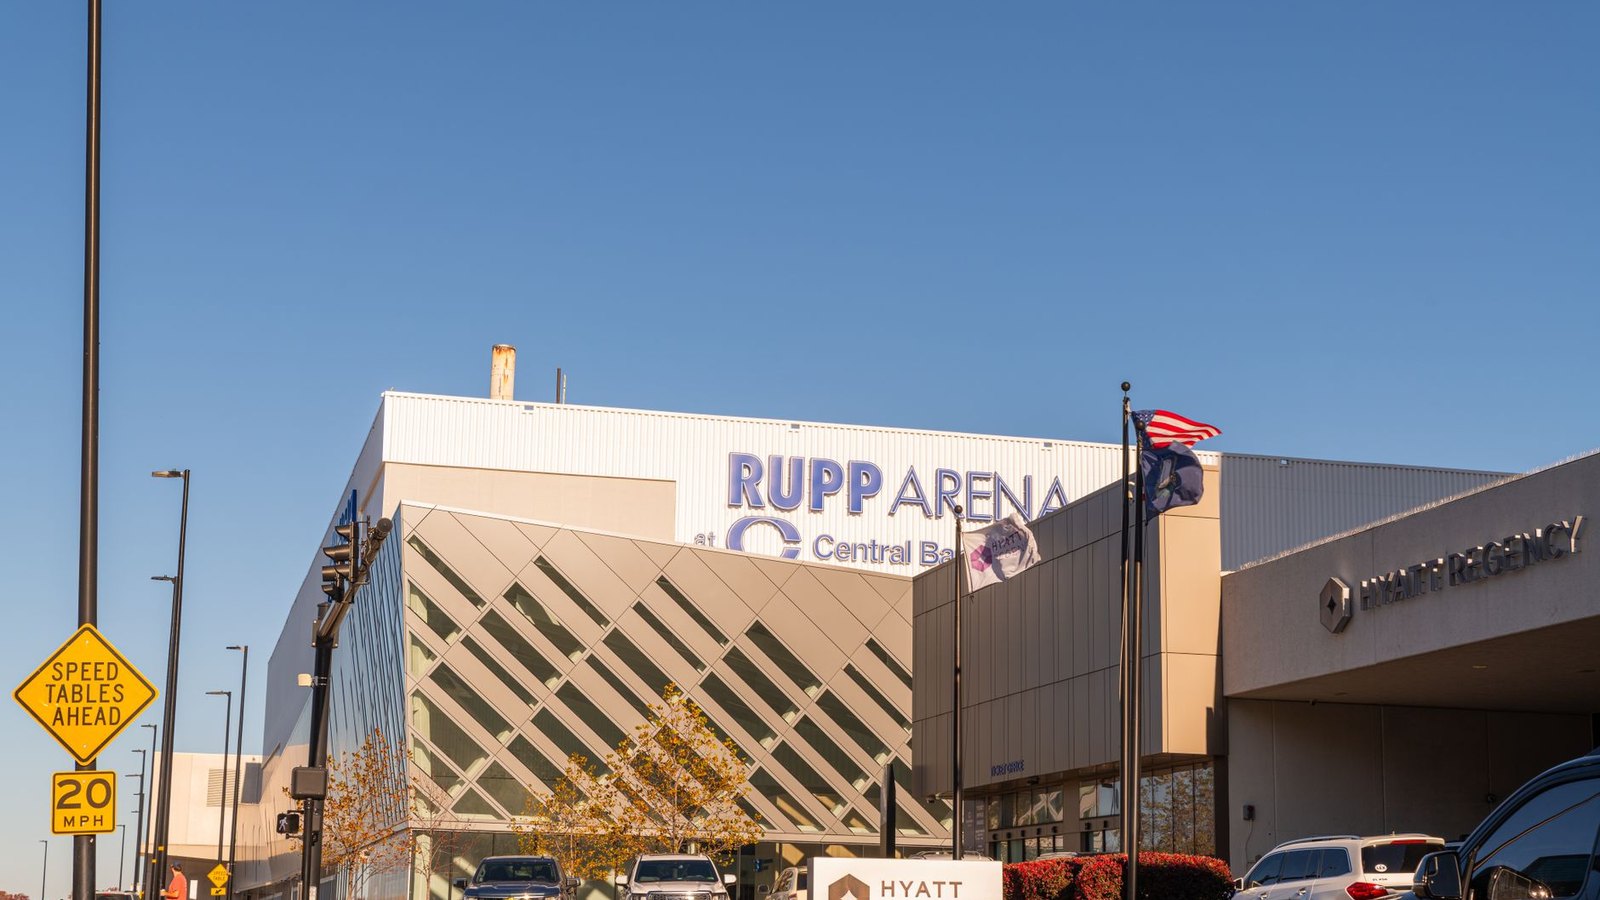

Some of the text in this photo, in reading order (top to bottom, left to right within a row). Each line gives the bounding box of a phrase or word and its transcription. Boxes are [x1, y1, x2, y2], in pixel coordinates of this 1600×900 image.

[728, 451, 1070, 523] RUPP ARENA
[694, 530, 715, 547] at
[813, 534, 912, 564] Central
[920, 540, 956, 566] Ba
[1360, 515, 1585, 611] HYATT REGENCY
[52, 662, 118, 681] SPEED
[45, 684, 124, 703] TABLES
[52, 706, 121, 726] AHEAD
[56, 778, 112, 809] 20
[63, 815, 103, 828] MPH
[881, 880, 963, 898] HYATT
